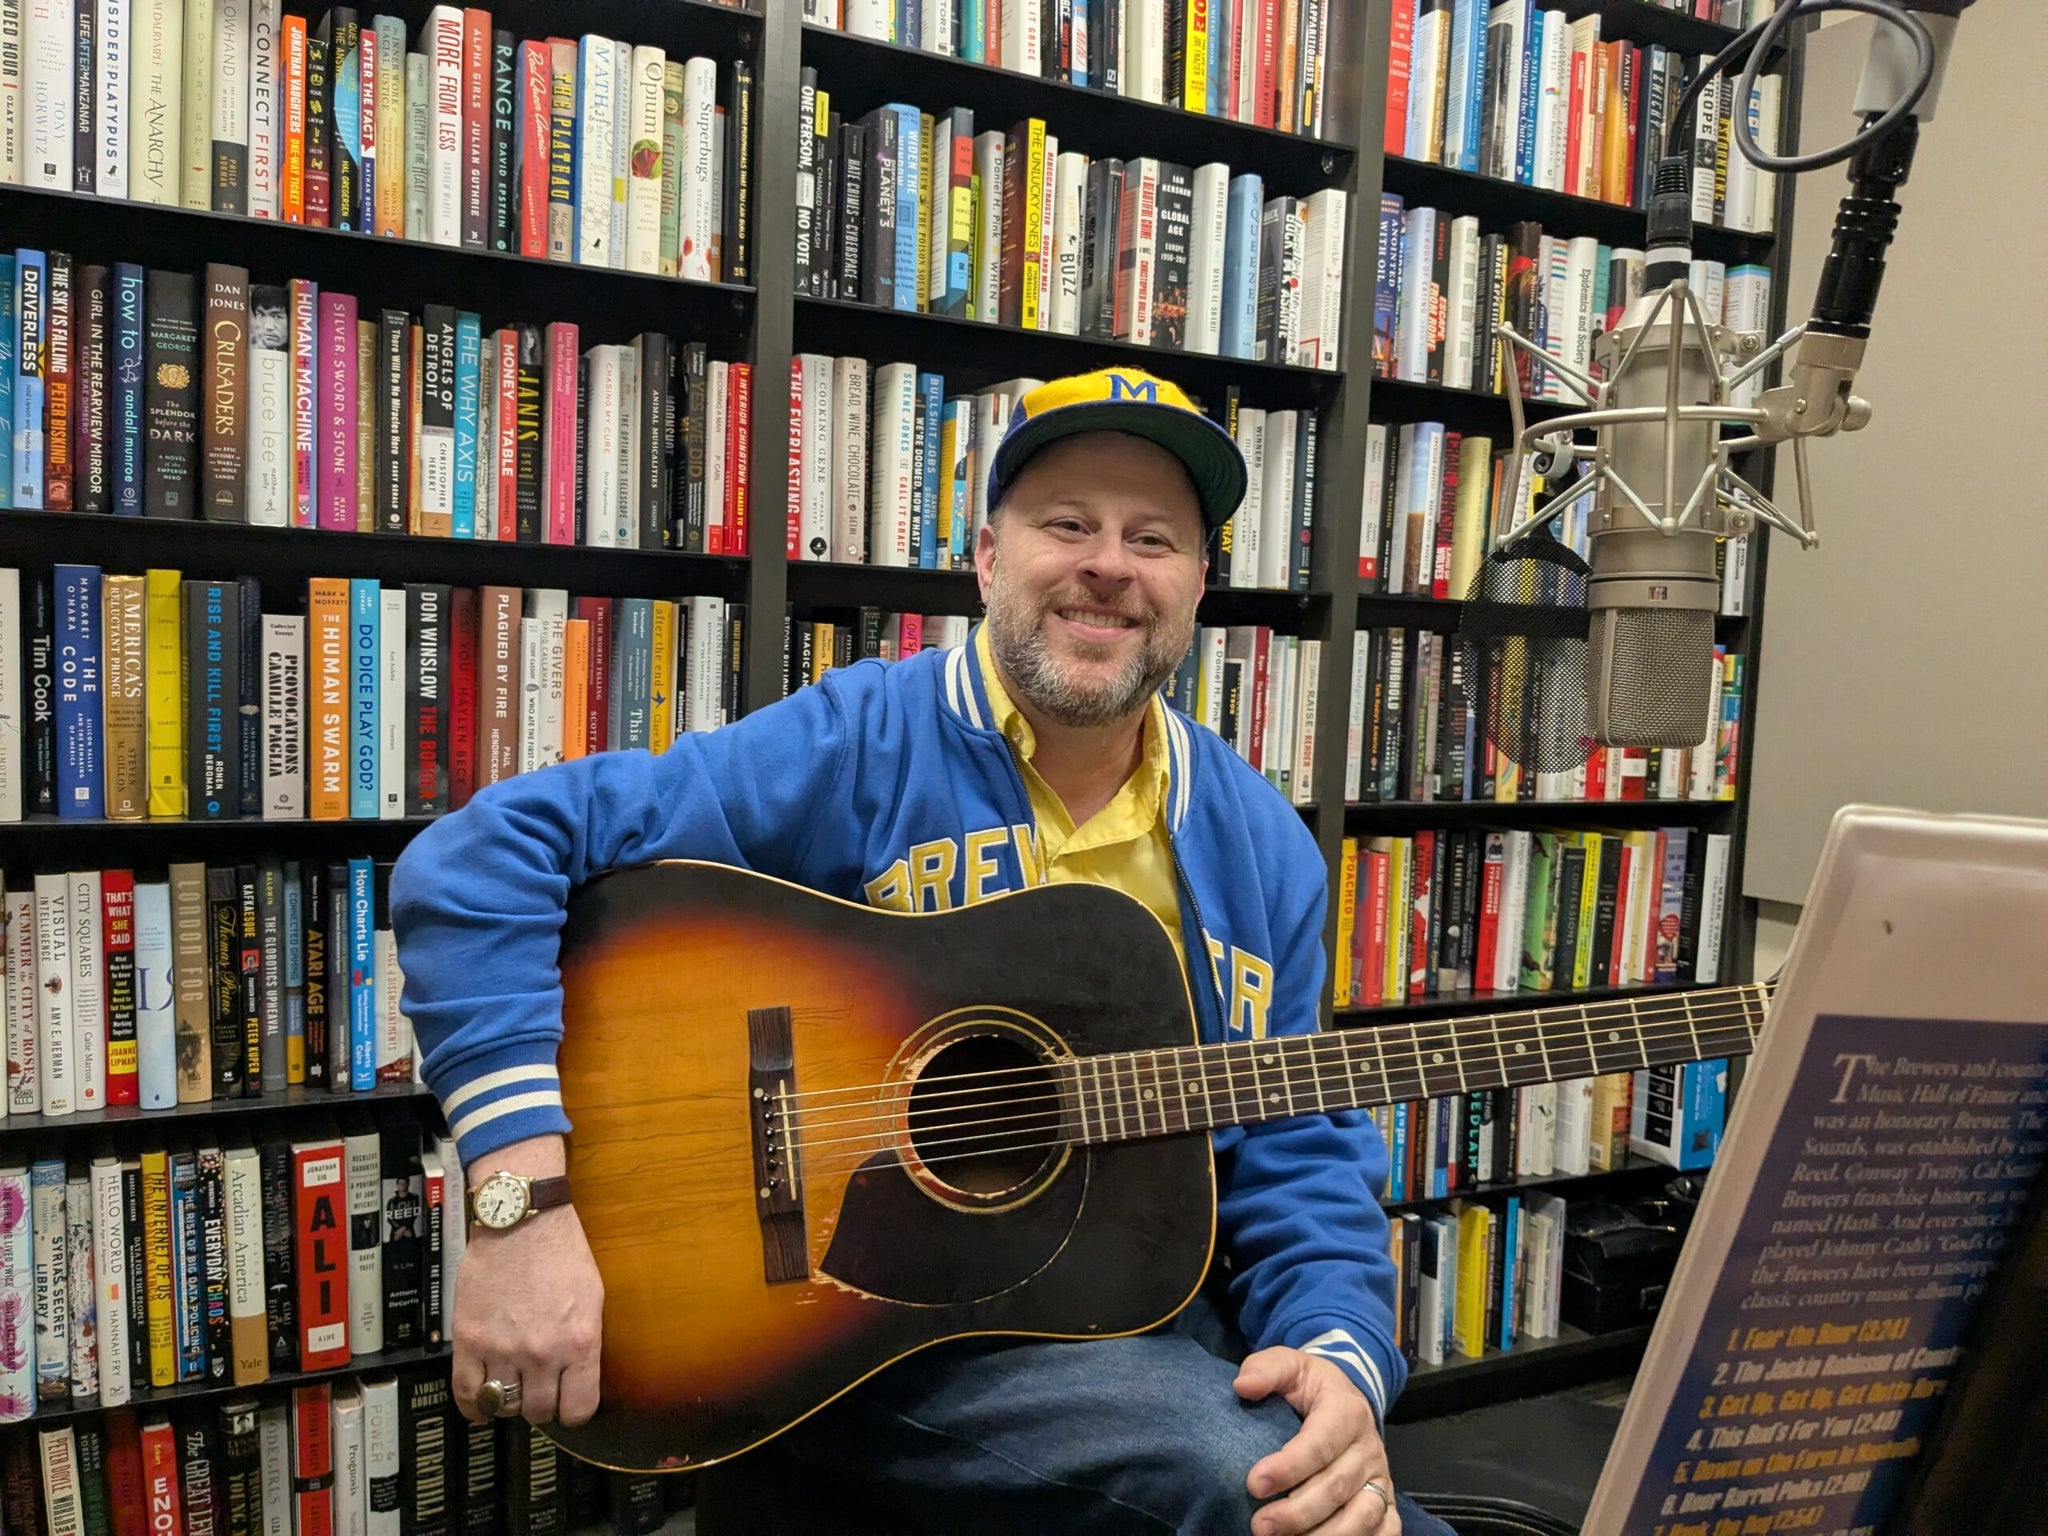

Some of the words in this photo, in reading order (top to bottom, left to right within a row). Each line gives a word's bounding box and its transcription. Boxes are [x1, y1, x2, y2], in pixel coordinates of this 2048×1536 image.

[3, 42, 18, 77] HOUR
[438, 18, 462, 67] MORE
[473, 29, 482, 69] ALPHA
[78, 12, 91, 134] LIFEAFTERMANZANAR
[152, 74, 161, 97] THE
[256, 22, 270, 127] CONNECT
[439, 67, 459, 114] FROM
[472, 72, 481, 109] GIRLS
[496, 45, 512, 130] RANGE
[554, 73, 572, 109] THE
[106, 71, 118, 158] PLATYPUS
[639, 61, 664, 133] Opium
[801, 85, 815, 110] ONE
[144, 98, 164, 188] ANARCHY
[439, 117, 456, 152] LESS
[695, 101, 713, 183] Superbugs
[797, 112, 813, 168] PERSON,
[1033, 127, 1042, 150] THE
[255, 134, 269, 192] FIRST
[552, 117, 571, 200] PLATEAU
[993, 158, 1002, 199] Daniel
[880, 159, 891, 214] PLANET
[1031, 152, 1041, 210] UNLUCKY
[798, 210, 810, 230] NO
[880, 216, 888, 228] 3
[991, 215, 1000, 238] Pink
[994, 201, 1001, 212] H.
[1161, 210, 1190, 224] GLOBAL
[796, 232, 810, 265] VOTE
[1030, 214, 1039, 248] ONES
[1168, 224, 1184, 236] AGE
[1060, 252, 1077, 296] BUZZ
[1246, 192, 1260, 315] SQUEEZED
[52, 267, 68, 292] THE
[121, 276, 143, 322] how
[215, 284, 241, 295] DAN
[990, 262, 998, 300] WHEN
[1580, 267, 1592, 313] Epidemics
[23, 269, 38, 371] DRIVERLESS
[52, 294, 67, 318] SKY
[52, 320, 66, 329] IS
[91, 289, 103, 323] GIRL
[209, 298, 244, 310] JONES
[297, 292, 312, 354] HUMAN
[1578, 315, 1588, 334] and
[91, 326, 102, 337] IN
[121, 331, 138, 348] to
[333, 303, 345, 354] SILVER,
[462, 322, 479, 368] THE
[52, 331, 66, 374] FALLING
[91, 339, 102, 362] THE
[426, 334, 438, 397] DETROIT
[442, 324, 454, 384] ANGELS
[502, 343, 516, 400] MONEY
[1575, 335, 1586, 366] Society
[91, 363, 102, 429] REARVIEW
[214, 321, 241, 436] CRUSADERS
[262, 357, 282, 421] bruce
[333, 357, 345, 410] SWORD
[461, 375, 477, 423] WHY
[848, 374, 861, 408] BREAD,
[1105, 374, 1160, 403] M
[125, 389, 138, 432] randall
[151, 408, 195, 419] SPLENDOR
[296, 369, 312, 451] MACHINE
[334, 416, 344, 425] &
[442, 390, 452, 411] OF
[518, 369, 540, 442] JANIS
[929, 378, 939, 438] BULLSHIT
[151, 429, 195, 442] DARK
[262, 430, 282, 462] lee
[848, 412, 860, 440] WINE,
[90, 434, 102, 494] MIRROR
[123, 437, 134, 482] munroe
[333, 431, 345, 474] STONE
[458, 429, 476, 483] AXIS
[501, 428, 514, 477] TABLE
[847, 445, 860, 501] CHOCOLATE
[928, 444, 937, 474] JOBS
[1305, 436, 1315, 478] SOCIALIST
[1303, 481, 1313, 527] MANIFESTO
[208, 588, 221, 623] RISE
[421, 593, 437, 620] DON
[498, 594, 508, 659] PLAGUED
[33, 636, 50, 668] Tim
[124, 588, 141, 697] AMERICA'S
[208, 630, 221, 662] AND
[359, 625, 372, 649] DO
[802, 633, 811, 667] MAGIC
[62, 647, 76, 702] CODE
[83, 656, 95, 692] THE
[322, 628, 340, 704] HUMAN
[359, 656, 372, 694] DICE
[419, 628, 437, 698] WINSLOW
[497, 662, 507, 681] BY
[1388, 637, 1403, 710] STRONGHOLD
[34, 675, 51, 721] Cook
[208, 668, 221, 702] KILL
[269, 652, 282, 719] CAMILLE
[497, 687, 506, 719] FIRE
[207, 708, 220, 752] FIRST
[284, 655, 298, 774] PROVOCATIONS
[359, 700, 372, 740] PLAY
[419, 706, 437, 734] THE
[1306, 691, 1315, 733] RAISE
[269, 725, 282, 777] PAGLIA
[322, 714, 340, 792] SWARM
[359, 747, 373, 791] GOD?
[419, 741, 437, 798] BORDER
[1303, 735, 1312, 767] READER
[78, 883, 90, 912] CITY
[106, 892, 132, 903] THAT'S
[356, 870, 367, 894] How
[1346, 856, 1355, 915] POACHED
[40, 896, 50, 961] INTELLIGENCE
[52, 896, 65, 961] VISUAL
[108, 906, 131, 917] WHAT
[112, 920, 129, 931] SHE
[179, 880, 201, 960] LONDON
[242, 884, 255, 938] KAFKAESQUE
[356, 899, 367, 942] Charts
[78, 918, 91, 977] SQUARES
[111, 934, 130, 945] SAID
[308, 930, 323, 974] ATARI
[356, 945, 365, 961] Lie
[181, 970, 203, 1001] FOG
[308, 981, 323, 1014] AGE
[110, 1047, 135, 1057] JOANNE
[111, 1057, 135, 1066] LIPMAN
[107, 1175, 120, 1217] HELLO
[232, 1170, 250, 1238] Arcadian
[387, 1206, 421, 1219] REED
[53, 1236, 63, 1283] SYRIA'S
[109, 1223, 121, 1273] WORLD
[205, 1219, 221, 1282] EVERYDAY
[310, 1196, 336, 1315] ALI
[37, 1264, 48, 1319] LIBRARY
[235, 1244, 248, 1304] America
[52, 1288, 64, 1338] SECRET
[208, 1285, 223, 1325] CHAOS
[240, 1359, 262, 1370] Yale
